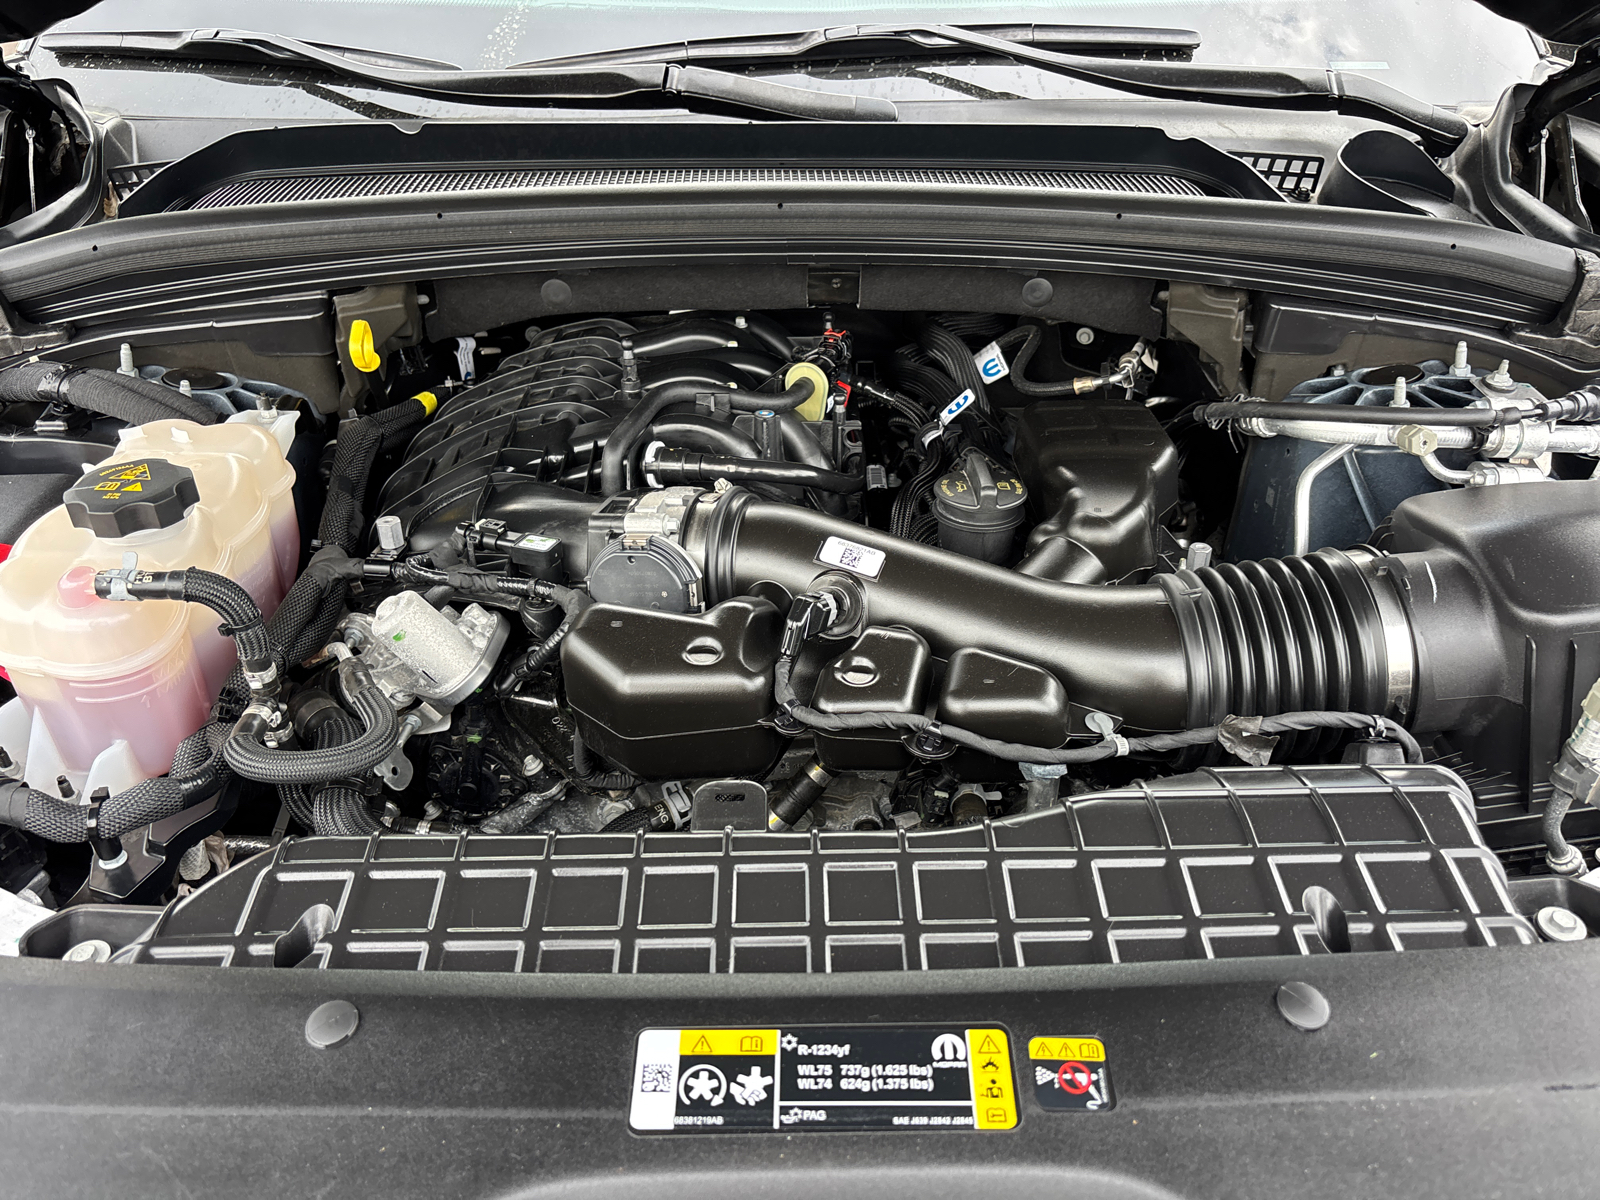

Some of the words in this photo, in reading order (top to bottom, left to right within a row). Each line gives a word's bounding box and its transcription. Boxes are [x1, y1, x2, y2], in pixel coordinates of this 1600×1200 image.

[654, 804, 668, 823] ENG
[797, 1044, 850, 1057] R-1234yf
[797, 1065, 833, 1076] WL75
[840, 1065, 871, 1078] 737g
[871, 1064, 909, 1078] (1.625
[909, 1064, 934, 1077] lbs)
[797, 1078, 833, 1089] WL74
[840, 1078, 871, 1091] 624g
[871, 1078, 909, 1091] (1.375
[909, 1078, 934, 1091] lbs)
[803, 1110, 827, 1121] PAG
[892, 1116, 910, 1125] SAE
